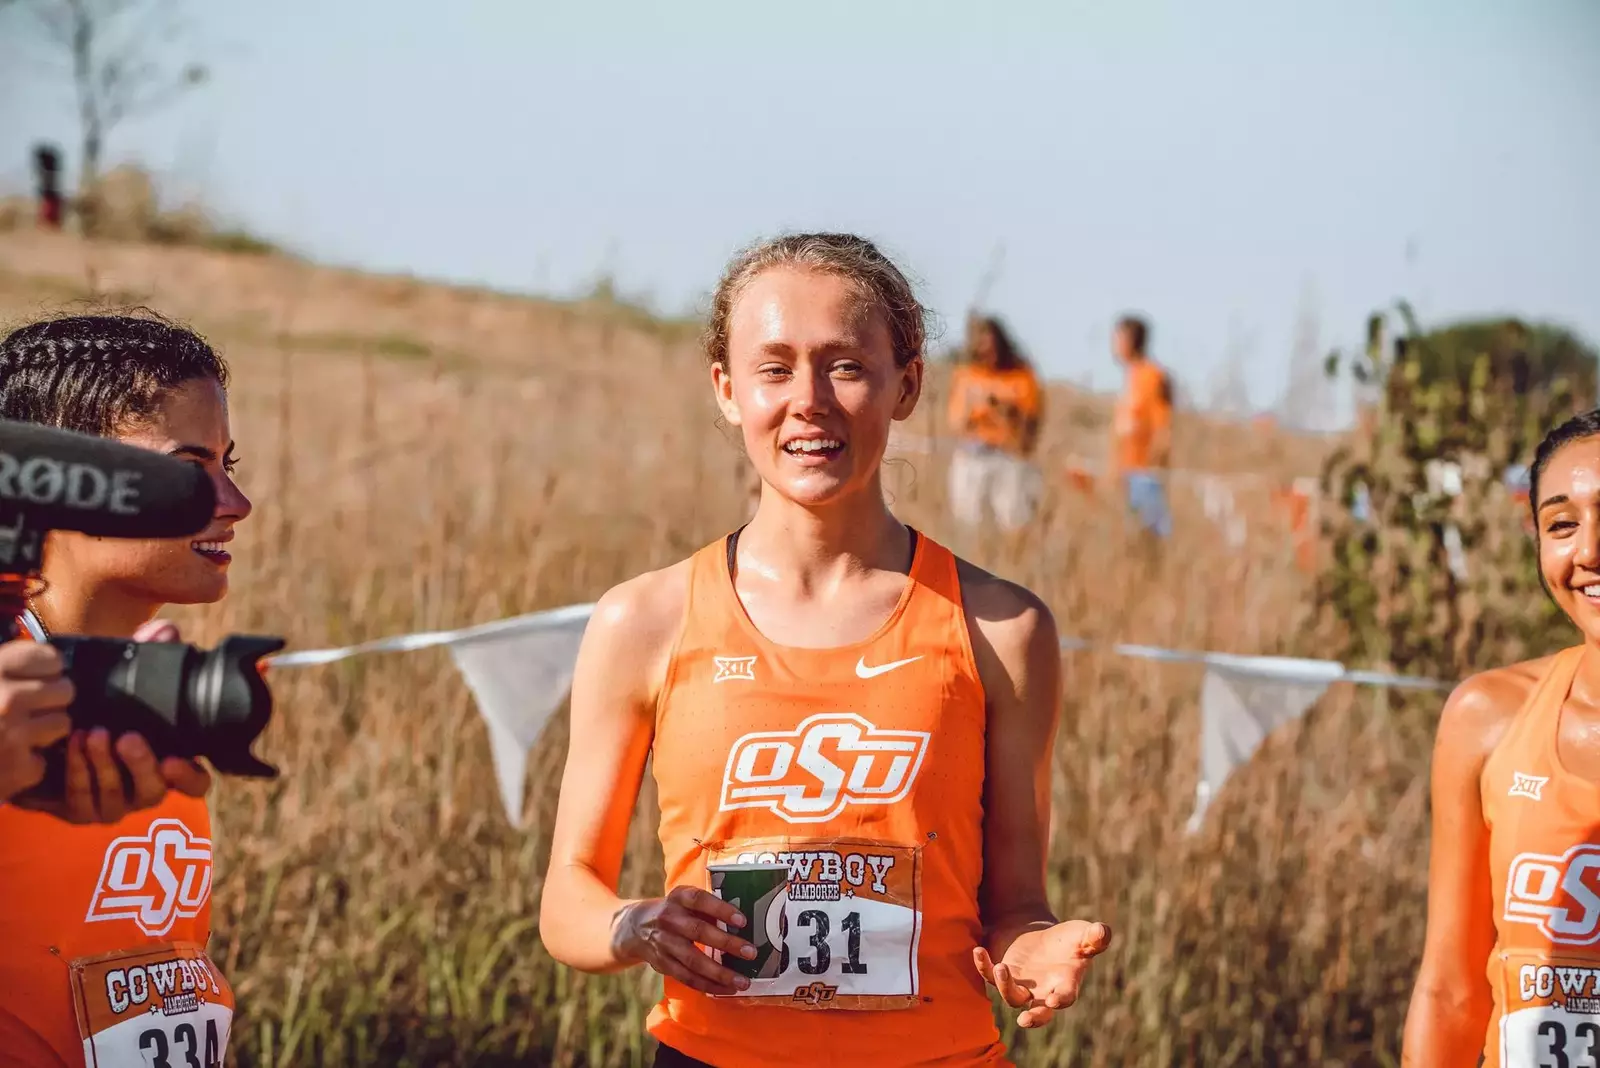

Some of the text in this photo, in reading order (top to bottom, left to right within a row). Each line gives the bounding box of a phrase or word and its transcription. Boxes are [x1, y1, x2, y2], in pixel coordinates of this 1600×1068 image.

[720, 660, 749, 676] XII
[728, 721, 922, 814] OSU
[1513, 776, 1540, 795] XII
[98, 827, 212, 926] OSU
[737, 850, 894, 893] WBOY
[788, 882, 841, 901] JAMBOREE
[779, 909, 868, 975] 31
[106, 957, 220, 1014] COWBOY
[793, 981, 840, 1006] OSU
[138, 1018, 222, 1068] 334
